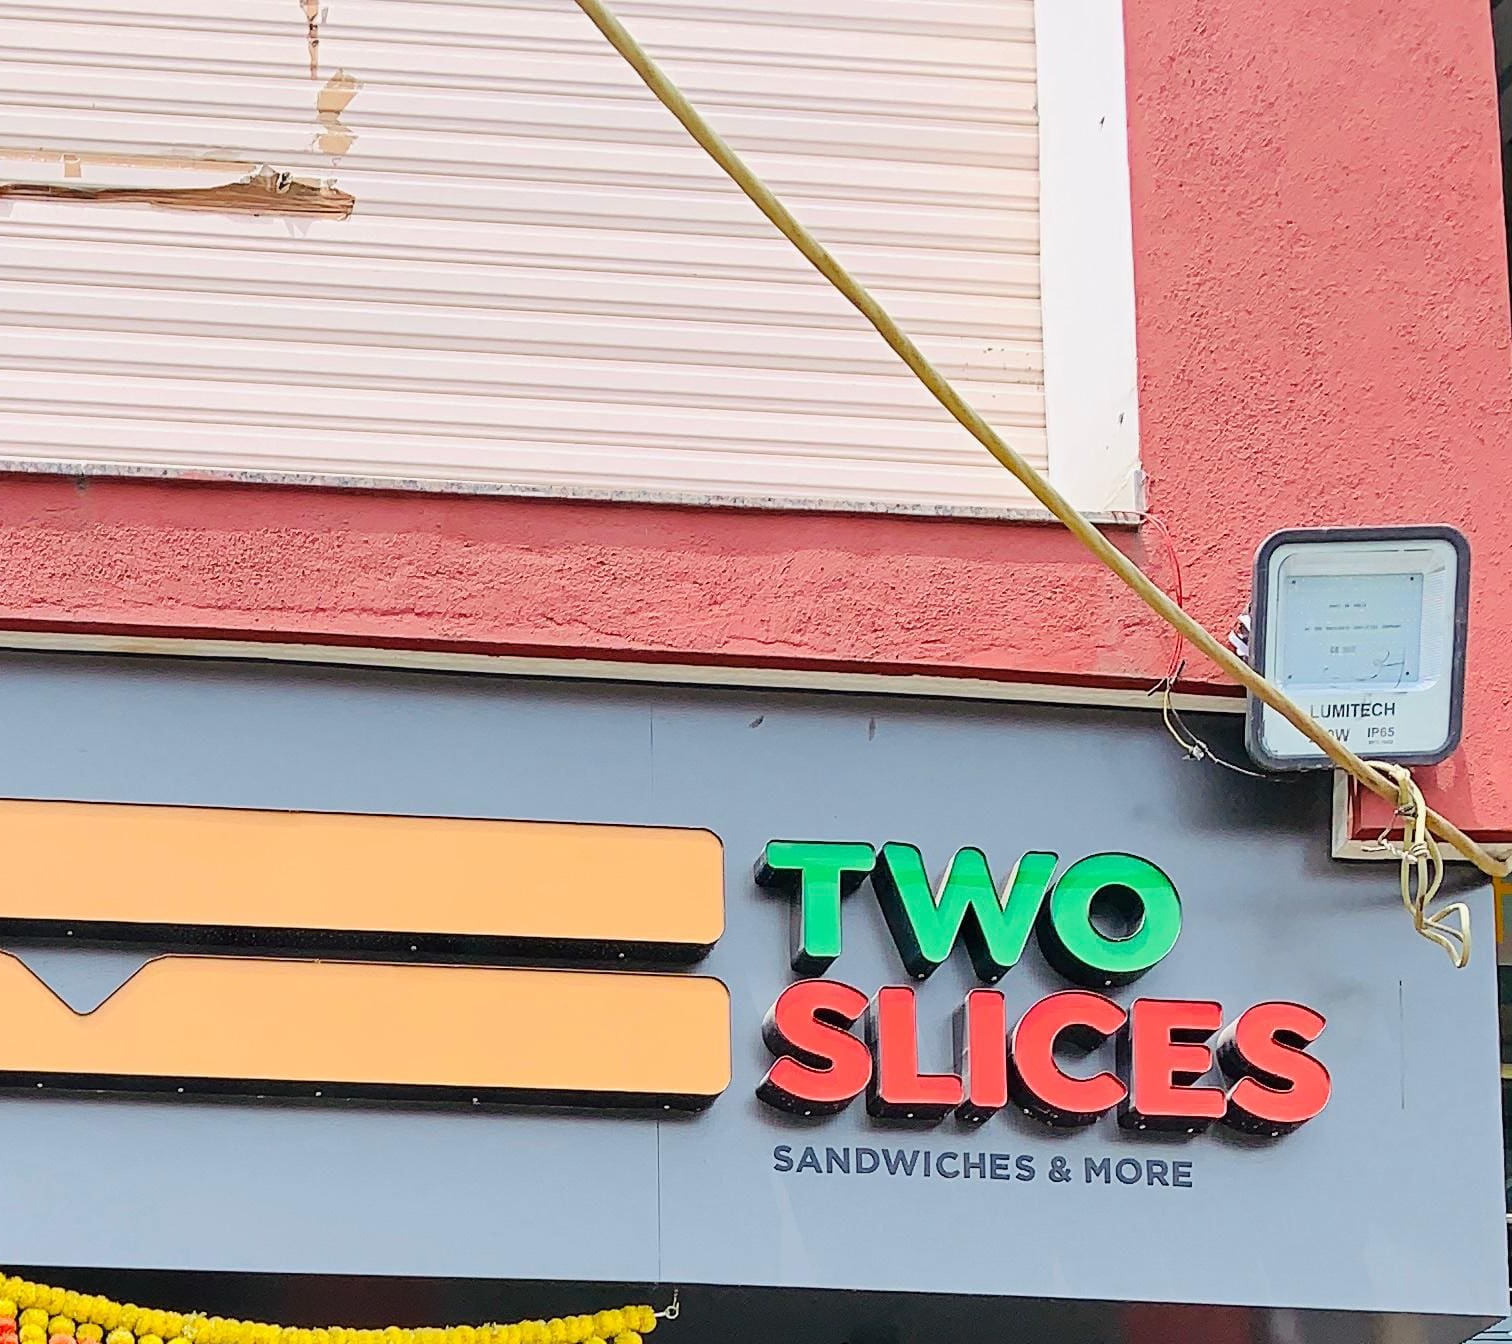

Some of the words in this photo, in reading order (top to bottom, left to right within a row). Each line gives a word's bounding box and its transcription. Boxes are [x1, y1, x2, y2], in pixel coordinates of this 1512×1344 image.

[1310, 702, 1396, 719] LUMITECH
[1367, 727, 1395, 738] IP65
[762, 838, 1183, 976] TWO
[766, 979, 1332, 1122] SLICES
[773, 1145, 1036, 1183] SANDWICHES
[1047, 1156, 1072, 1183] &
[1084, 1158, 1193, 1188] MORE
